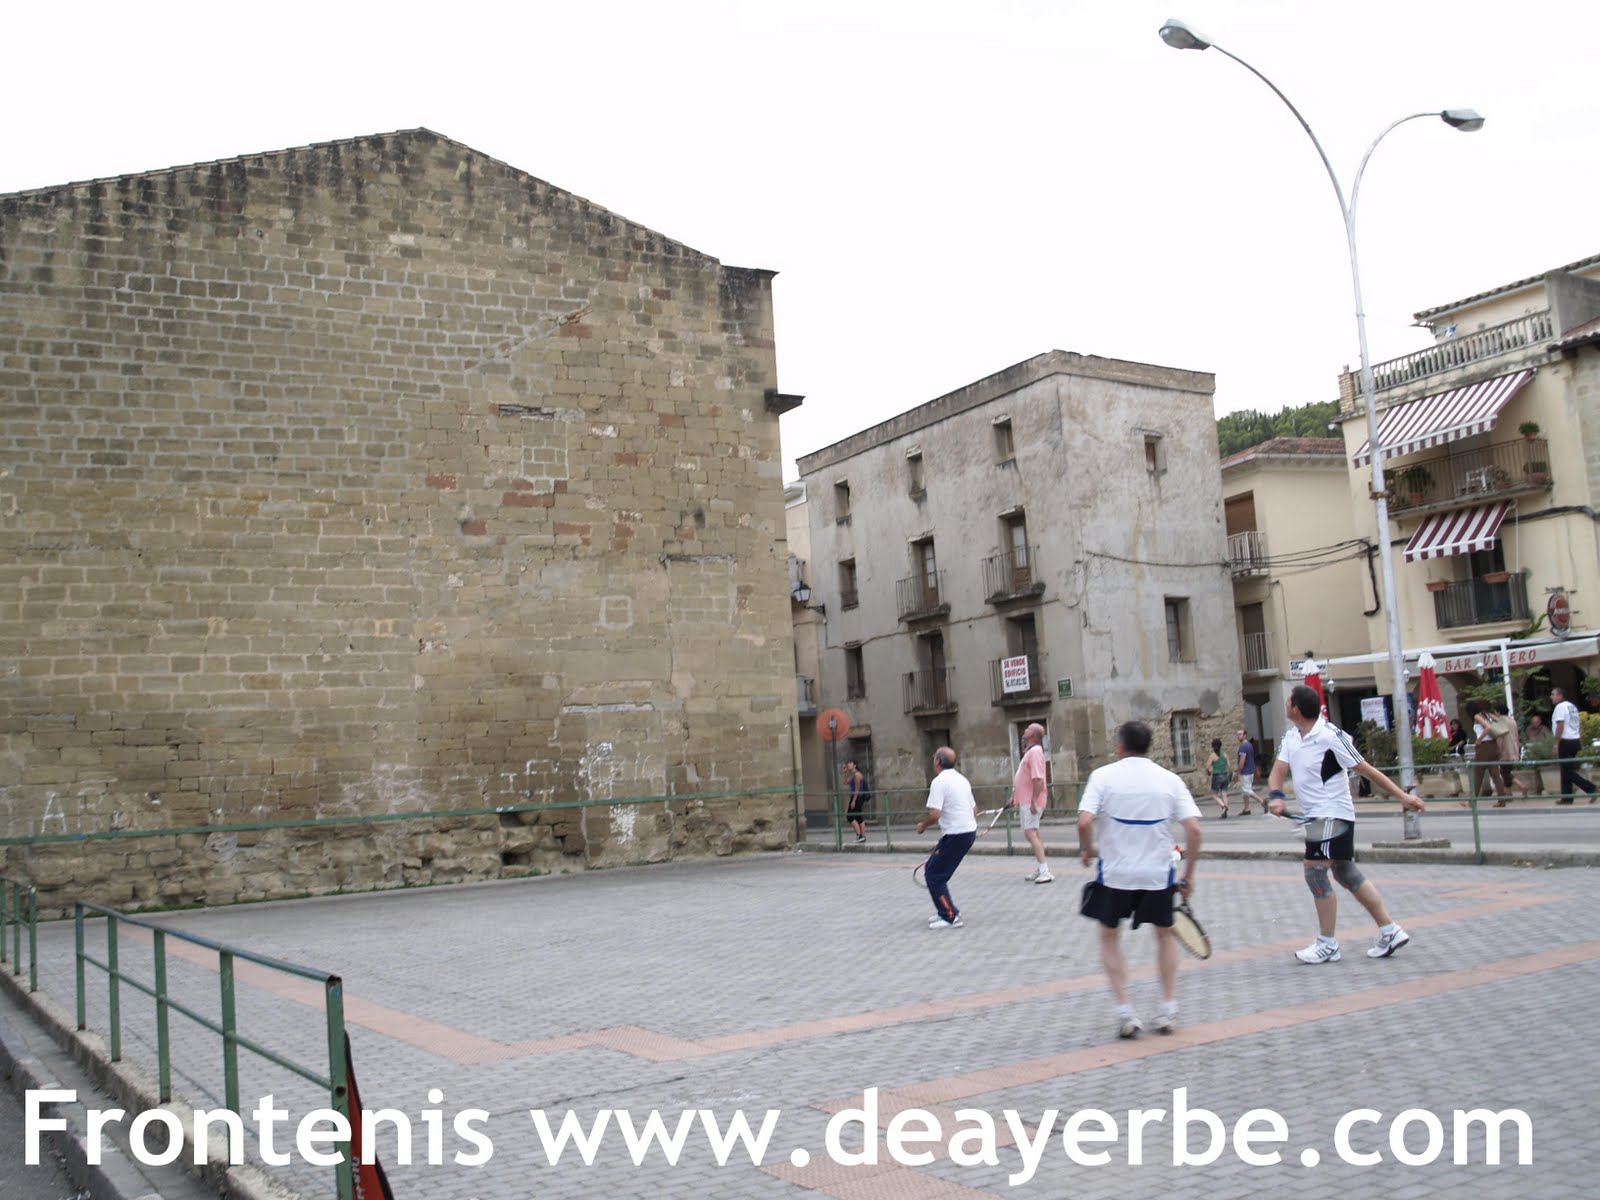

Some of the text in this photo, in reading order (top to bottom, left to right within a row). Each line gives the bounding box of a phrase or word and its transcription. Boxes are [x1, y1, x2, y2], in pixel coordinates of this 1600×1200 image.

[1010, 657, 1025, 667] VENDE
[1445, 649, 1537, 672] BAR VAERO
[1004, 667, 1026, 678] EDIFICIO
